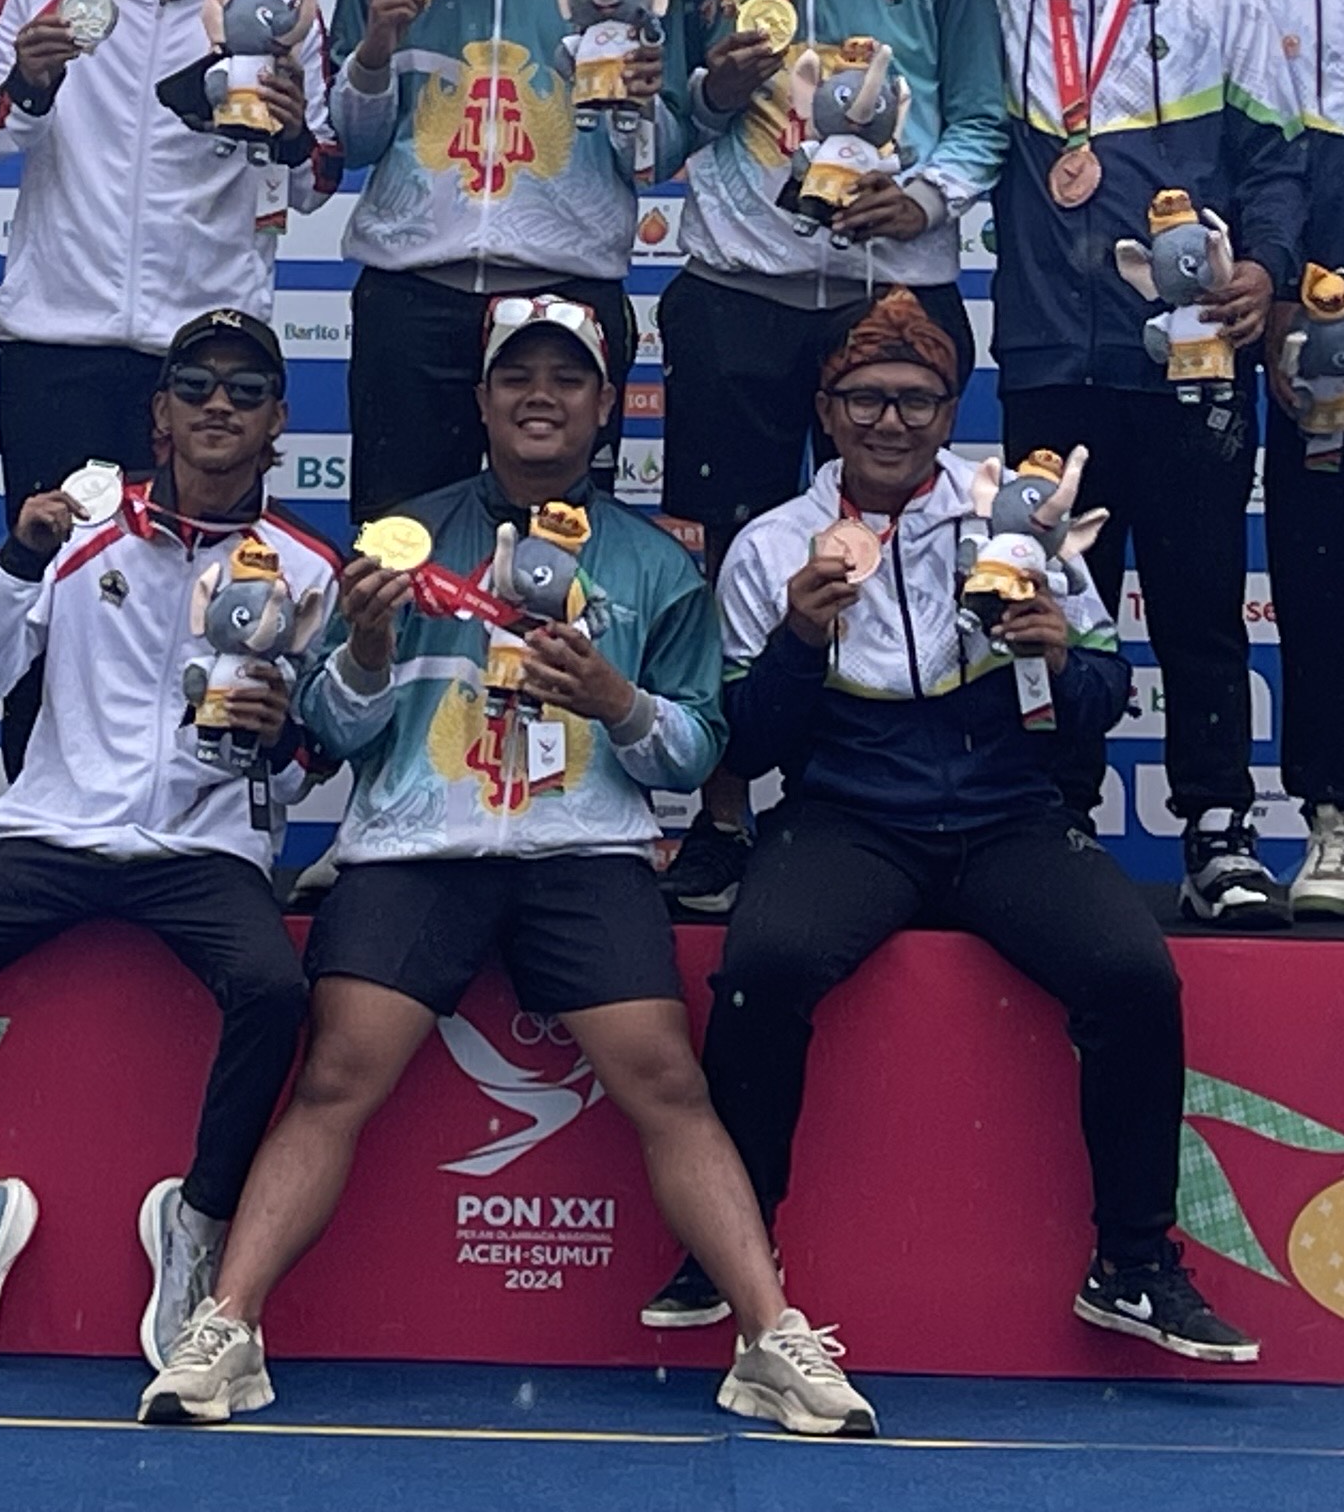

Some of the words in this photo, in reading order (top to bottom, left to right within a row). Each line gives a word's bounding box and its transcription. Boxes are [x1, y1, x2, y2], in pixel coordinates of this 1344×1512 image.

[284, 323, 339, 340] Barito
[297, 456, 346, 489] BS
[457, 1196, 540, 1226] PON
[550, 1198, 615, 1228] XXI
[457, 1244, 613, 1266] ACEH-SUMUT
[505, 1270, 562, 1289] 2024
